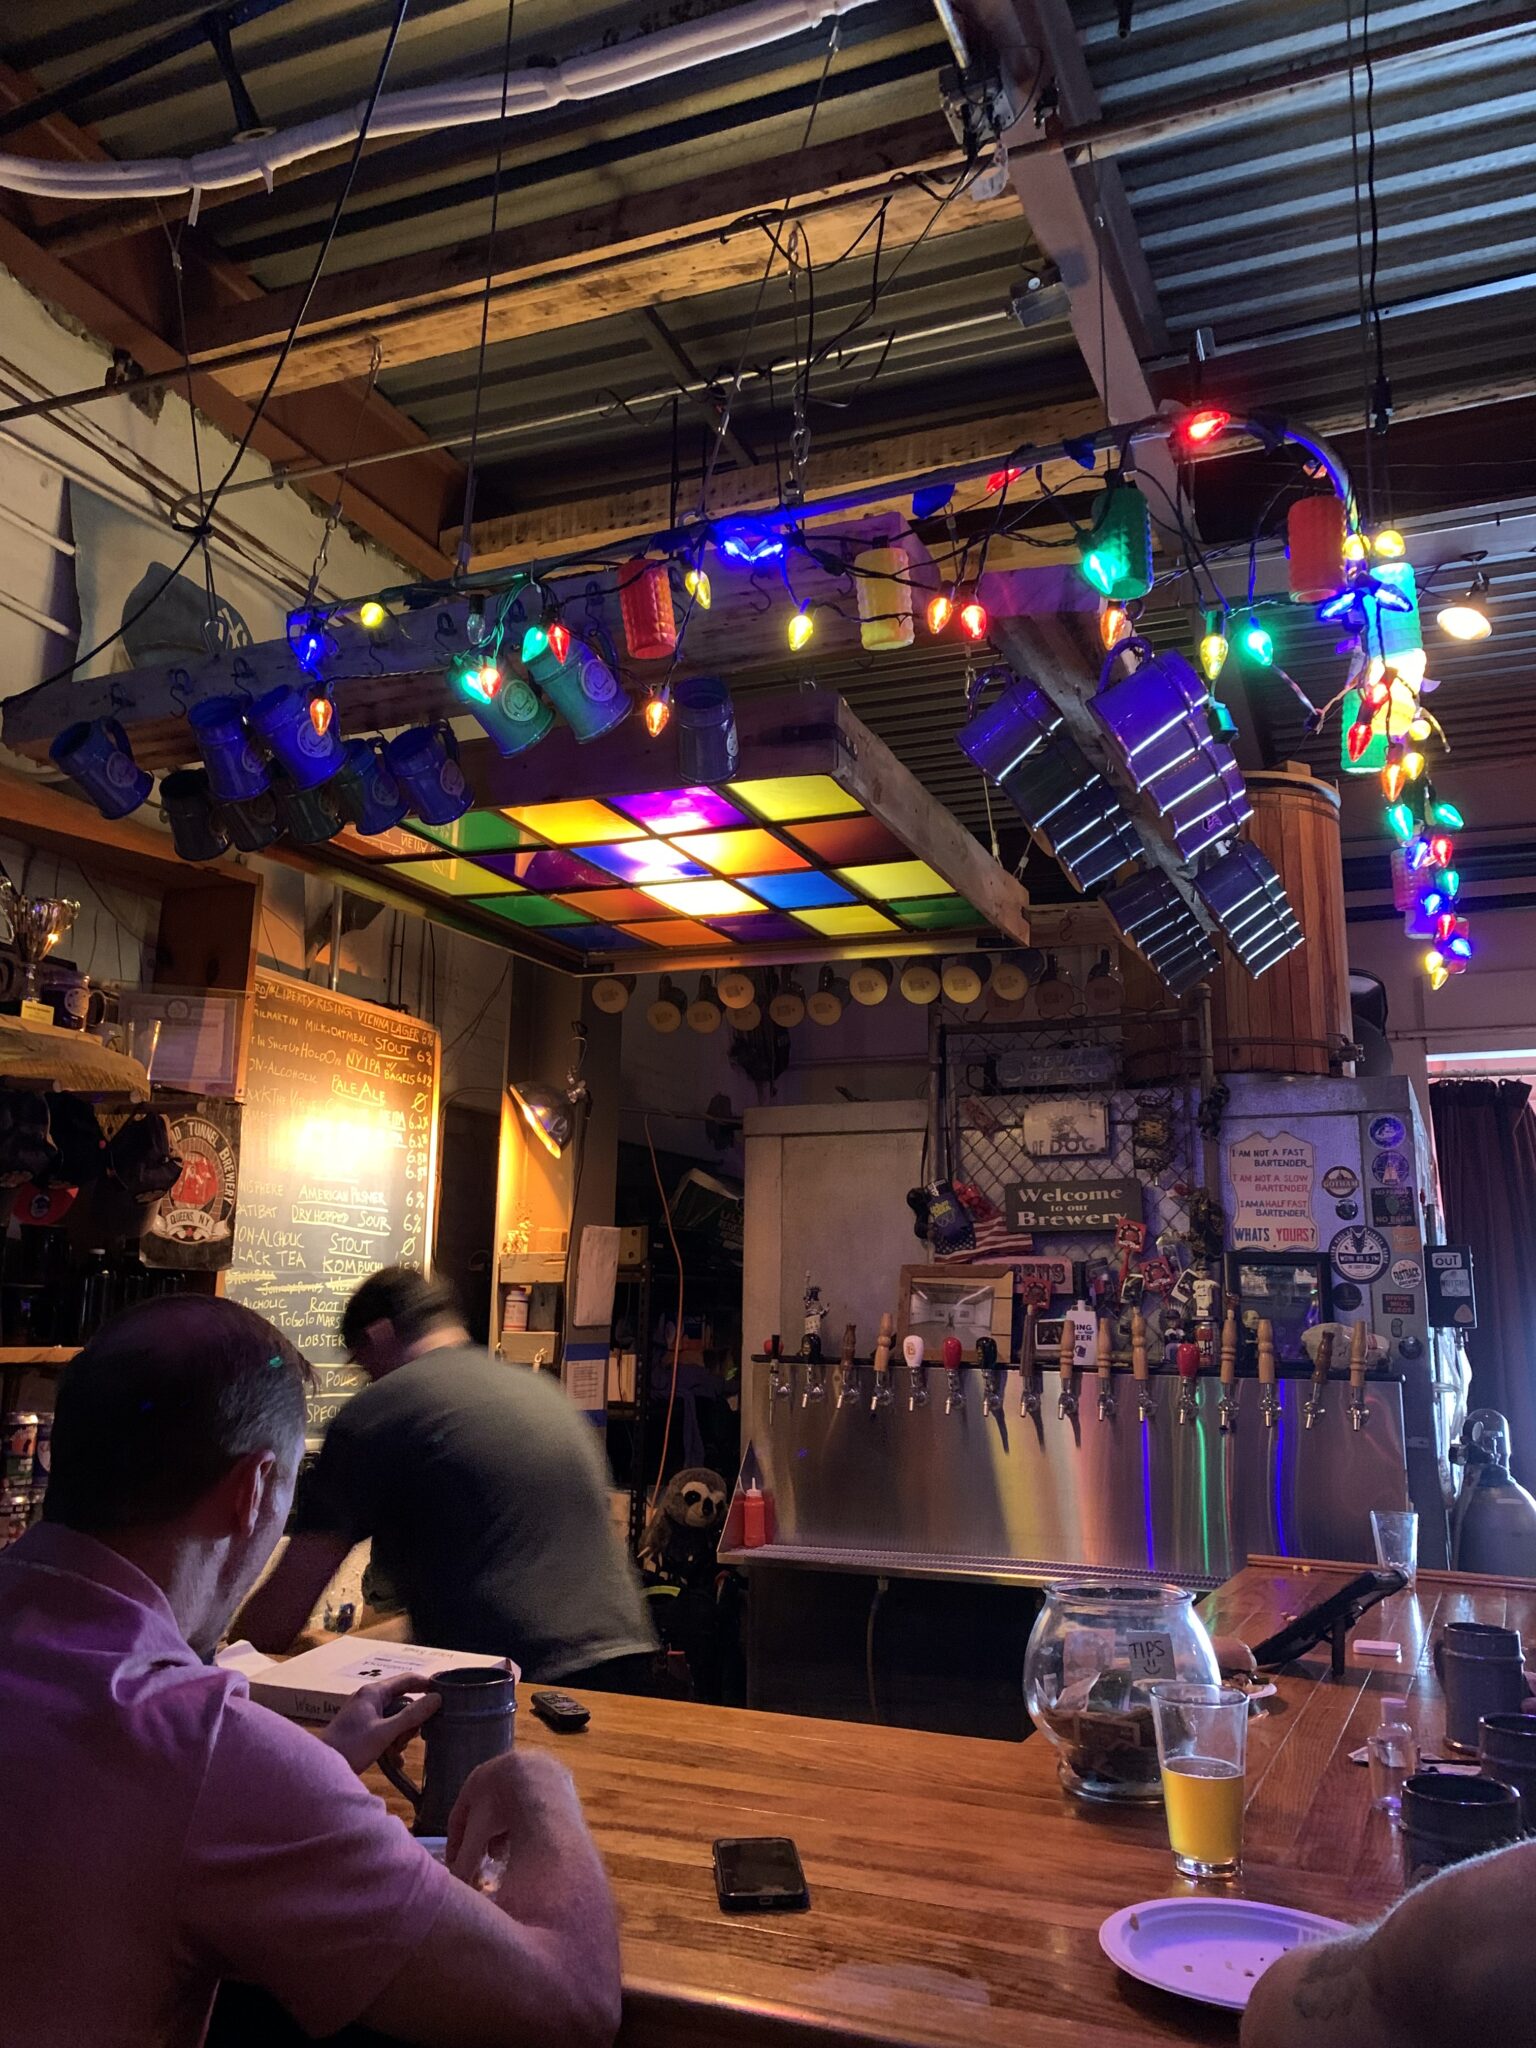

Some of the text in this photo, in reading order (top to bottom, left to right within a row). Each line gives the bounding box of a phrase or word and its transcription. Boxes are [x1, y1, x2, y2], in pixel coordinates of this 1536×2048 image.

[316, 998, 353, 1019] RISING
[357, 1010, 388, 1032] VIENNA
[390, 1022, 420, 1042] LAGER
[374, 1037, 411, 1056] STOUT
[1049, 1138, 1095, 1154] DOG
[1238, 1149, 1251, 1158] AM
[1253, 1149, 1269, 1157] NOT
[1282, 1148, 1305, 1157] FAST
[187, 1121, 219, 1148] TUNNEL
[218, 1146, 236, 1207] BREWERY
[1284, 1174, 1308, 1183] SLOW
[1323, 1178, 1359, 1188] GOTHAM
[297, 1185, 348, 1202] AMERICAN
[1018, 1187, 1123, 1203] Welcome
[1050, 1203, 1089, 1212] to our
[1287, 1200, 1307, 1208] FAST
[170, 1211, 195, 1225] QUEENS
[291, 1205, 312, 1223] DRY
[314, 1207, 349, 1224] HOPPED
[357, 1209, 391, 1231] SOUR
[1017, 1210, 1128, 1228] Brewery
[1233, 1227, 1270, 1242] WHATS
[328, 1232, 374, 1254] STOUT
[232, 1249, 272, 1266] LACK
[276, 1251, 306, 1269] TEA
[1435, 1255, 1458, 1266] OUT
[310, 1297, 339, 1312] ROOT
[316, 1313, 341, 1329] MARS
[298, 1334, 347, 1348] LOBSTER
[1128, 1640, 1165, 1659] TIPS
